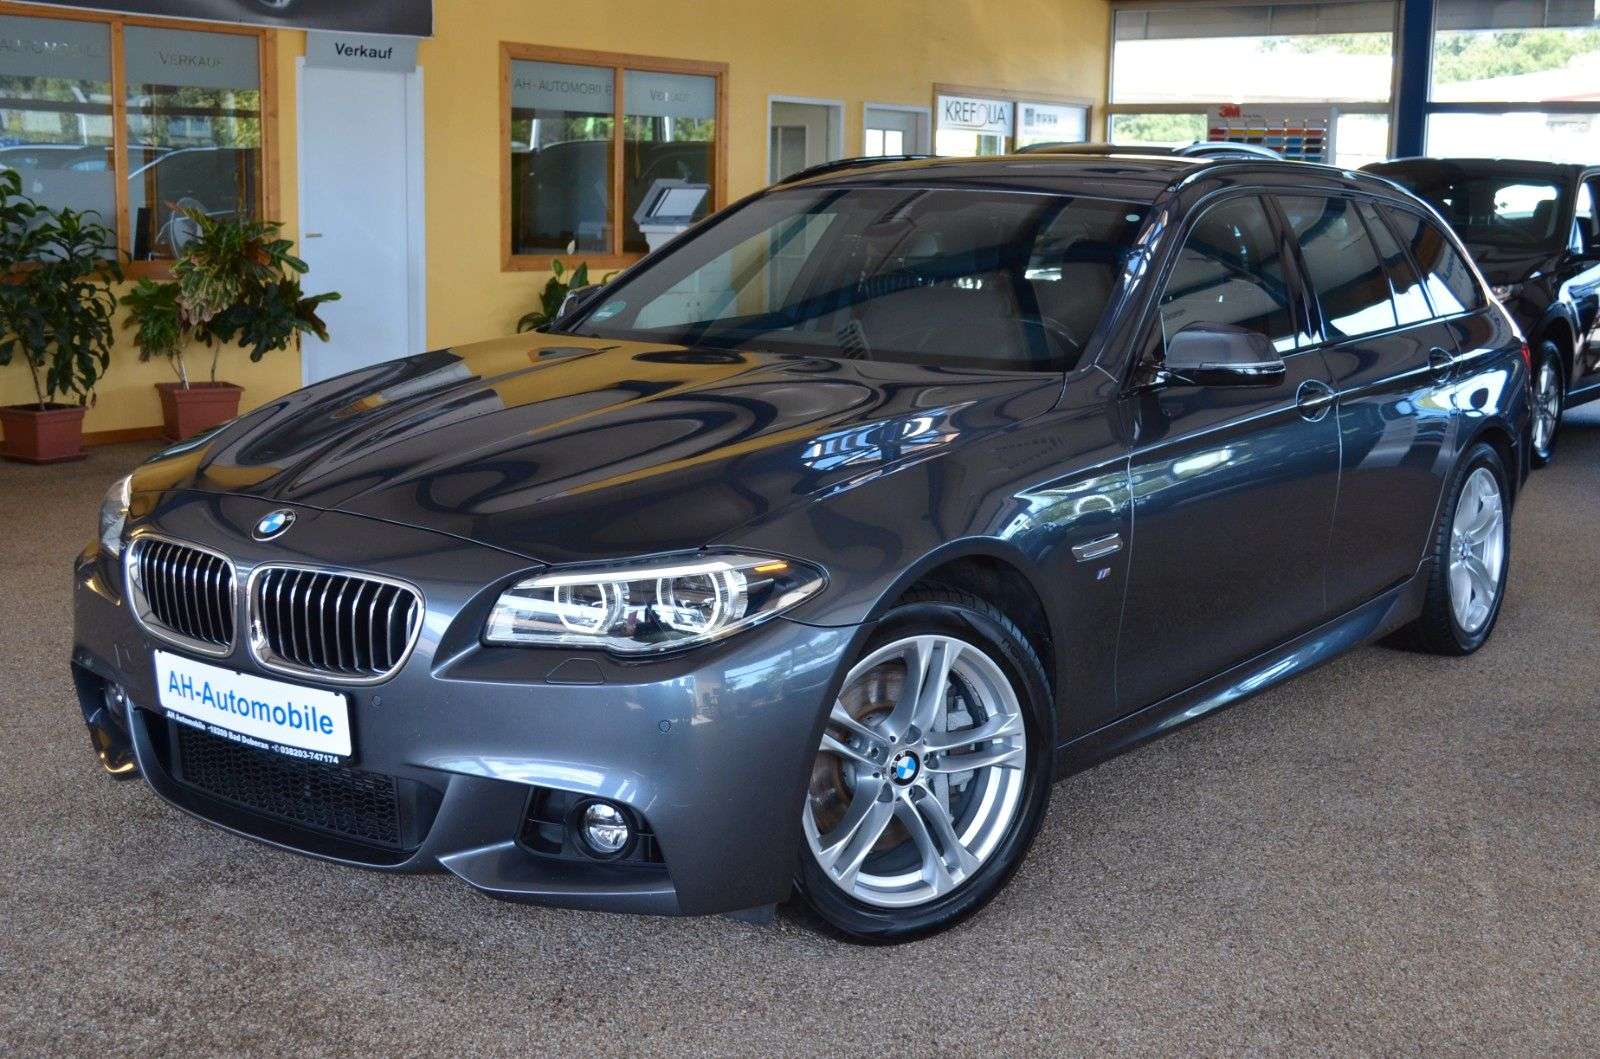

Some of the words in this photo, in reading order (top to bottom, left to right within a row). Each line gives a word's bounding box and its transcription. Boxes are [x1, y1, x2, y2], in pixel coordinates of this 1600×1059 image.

[158, 50, 225, 68] VERKAUF
[335, 42, 393, 60] Verkauf
[1219, 103, 1242, 118] 3M
[168, 670, 335, 735] AH-Automobile
[228, 731, 241, 742] Bad
